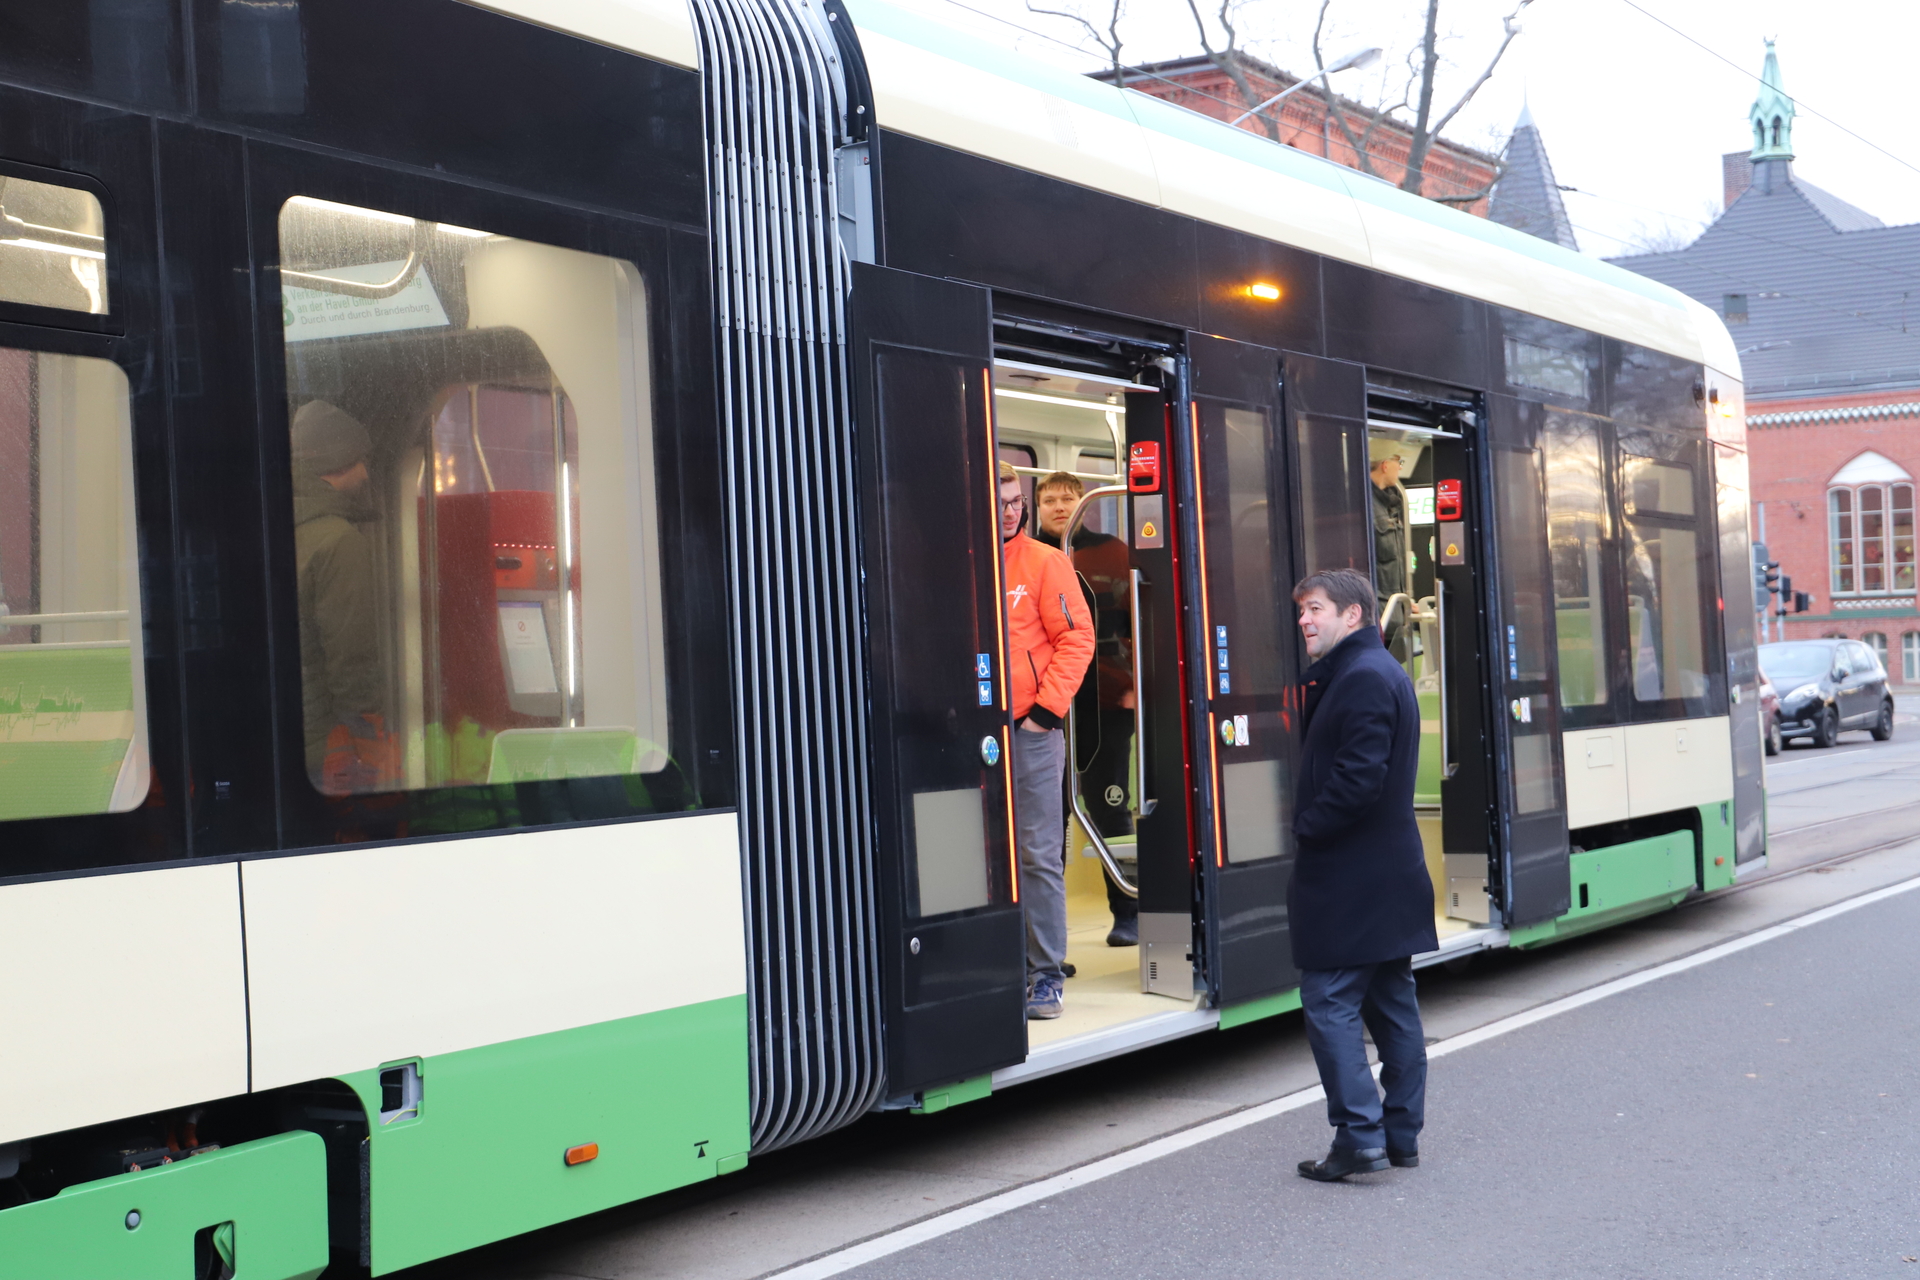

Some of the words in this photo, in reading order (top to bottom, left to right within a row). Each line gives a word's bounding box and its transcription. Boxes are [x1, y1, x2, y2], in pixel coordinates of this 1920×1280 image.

[297, 304, 308, 313] an
[309, 301, 323, 312] der
[325, 297, 350, 310] Havel
[301, 314, 326, 325] Durch
[329, 312, 345, 322] und
[347, 309, 372, 320] durch
[374, 304, 433, 316] Brandenburg.
